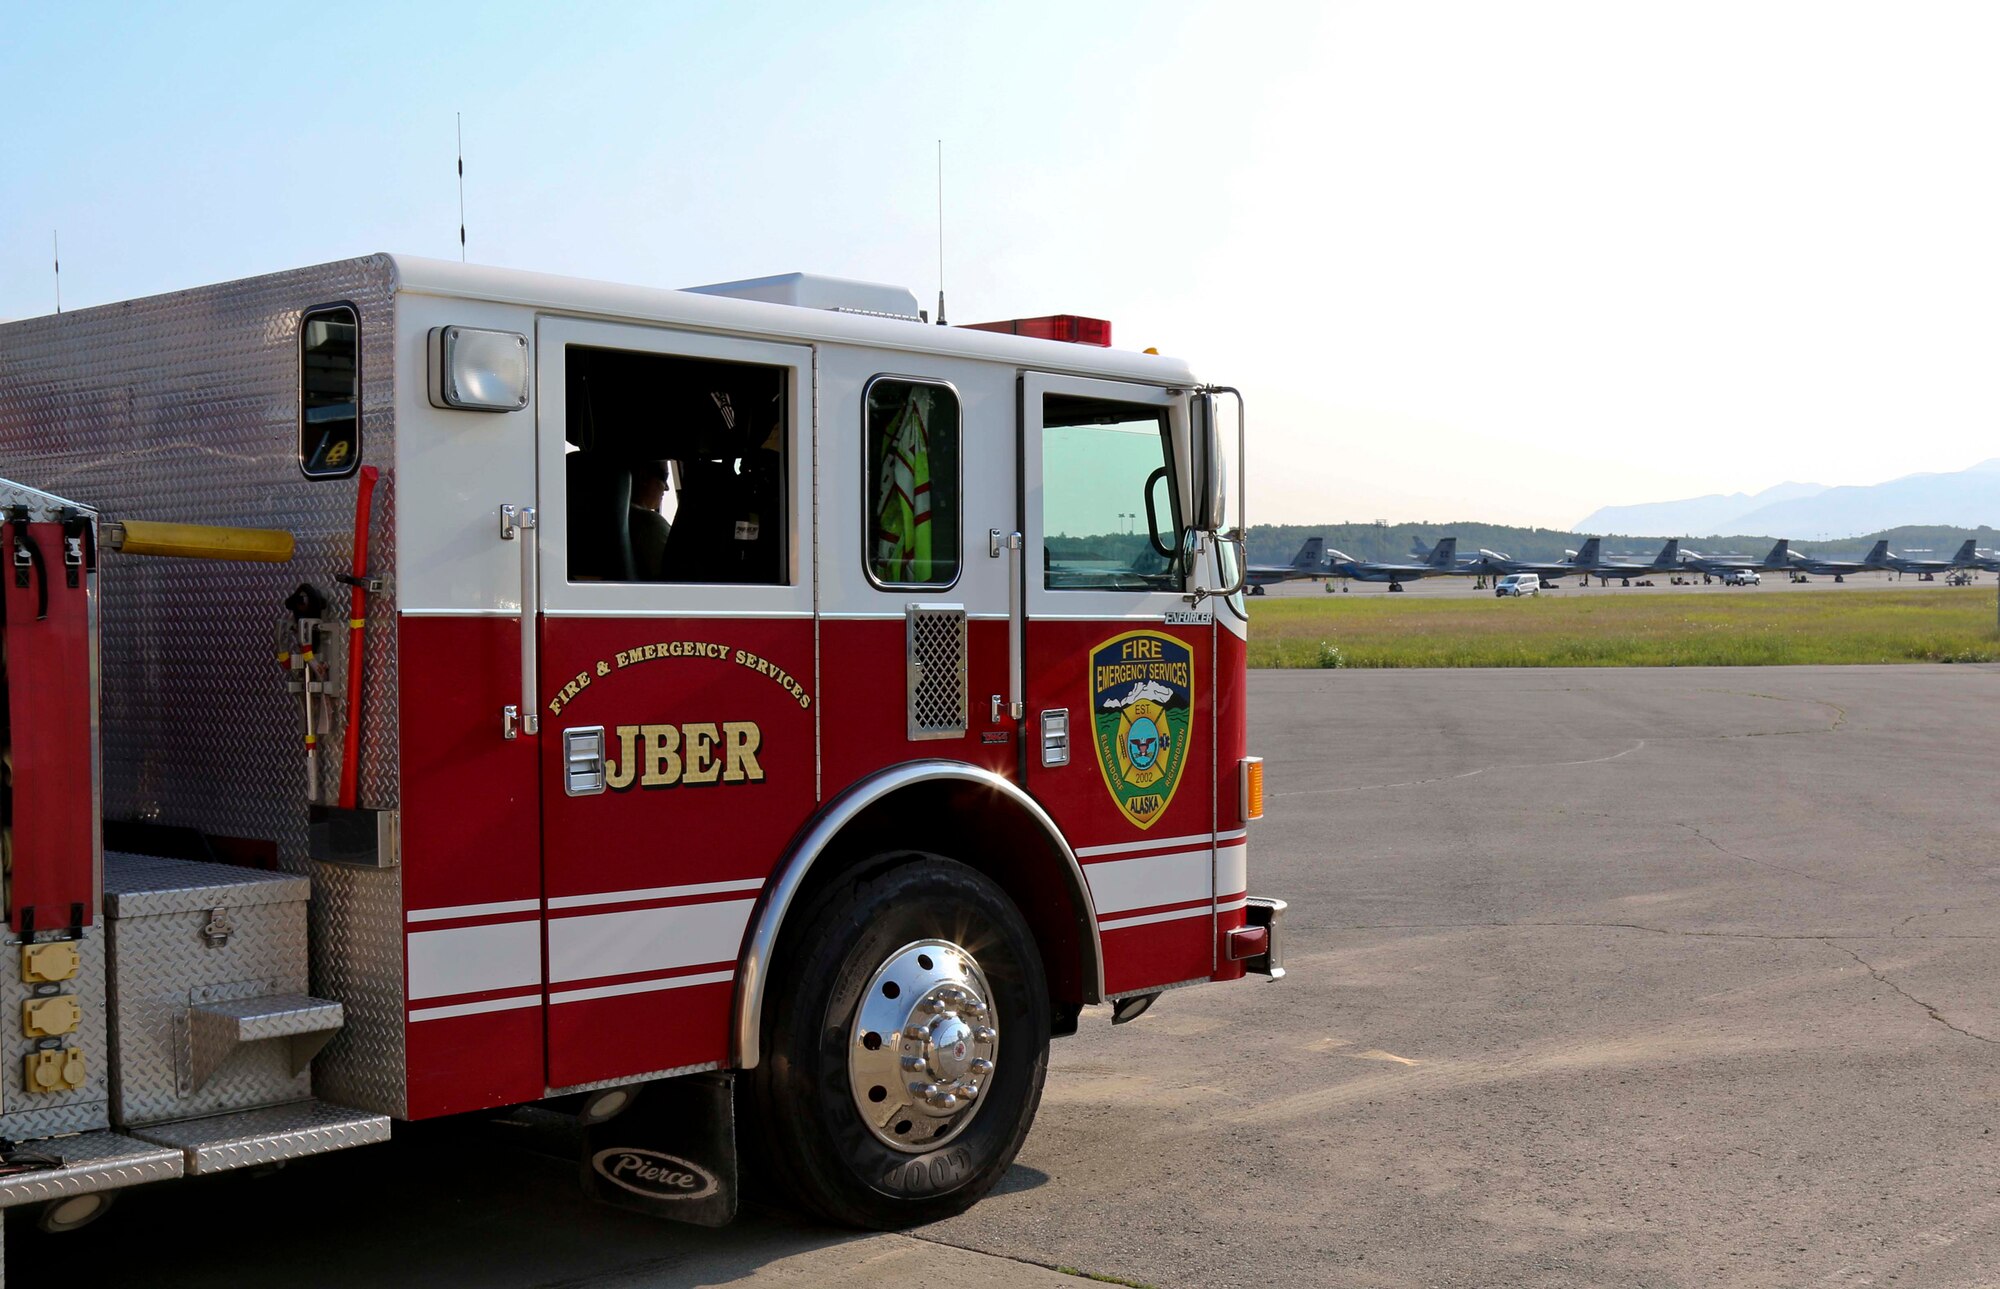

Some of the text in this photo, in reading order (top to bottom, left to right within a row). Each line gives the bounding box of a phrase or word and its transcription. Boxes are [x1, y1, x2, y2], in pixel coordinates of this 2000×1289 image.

[1165, 611, 1213, 624] ENFORCER
[1122, 639, 1163, 659] FIRE
[549, 641, 811, 716] FIRE & EMERGENCY SERVICES
[1097, 662, 1188, 693] EMERGENCY SERVICES
[1135, 704, 1152, 715] EST.
[604, 720, 765, 790] JBER
[1101, 734, 1124, 791] ELMENDORF
[1165, 728, 1185, 787] RICHARDSON
[1135, 772, 1153, 784] 2002
[1130, 795, 1159, 814] ALASKA
[613, 1154, 695, 1188] Pierce
